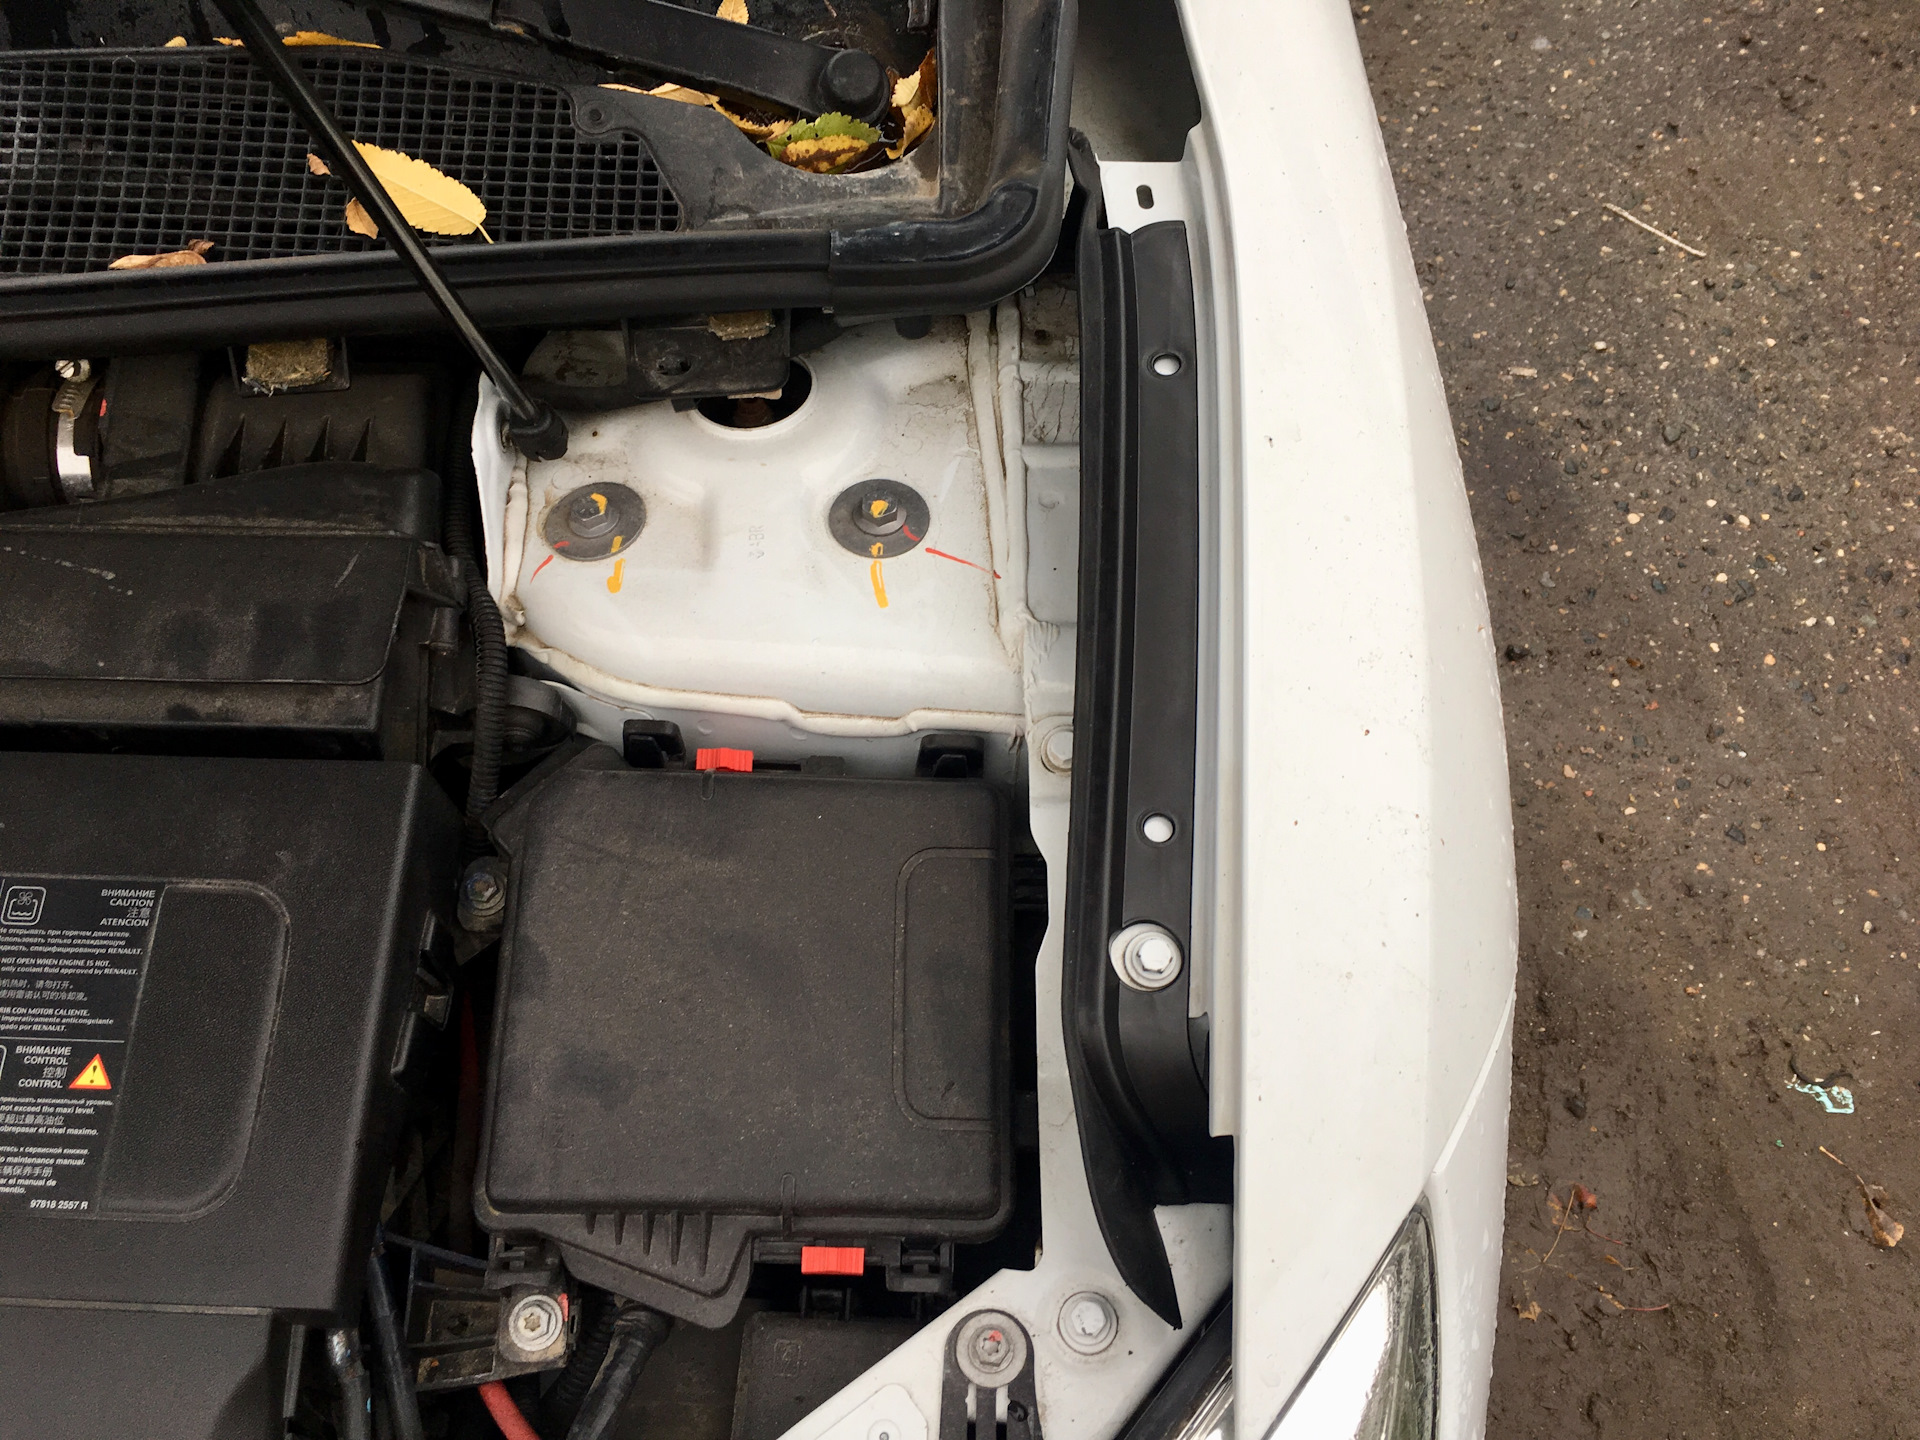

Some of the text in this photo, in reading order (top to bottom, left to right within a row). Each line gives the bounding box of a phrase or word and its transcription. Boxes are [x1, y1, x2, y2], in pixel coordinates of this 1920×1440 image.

[101, 888, 156, 898] ВНИМАНИЕ
[110, 898, 154, 908] CAUTION
[126, 908, 152, 918] 注意
[100, 918, 150, 927] ATENCION
[1, 1015, 114, 1025] imperativamente anticongelante
[16, 1046, 72, 1055] ВНИМАНИЕ
[24, 1056, 68, 1065] CONTROL
[42, 1066, 67, 1079] 控制
[18, 1079, 63, 1088] CONTROL
[6, 1156, 55, 1164] maintenance
[30, 1199, 88, 1210] 97818 2557 R
